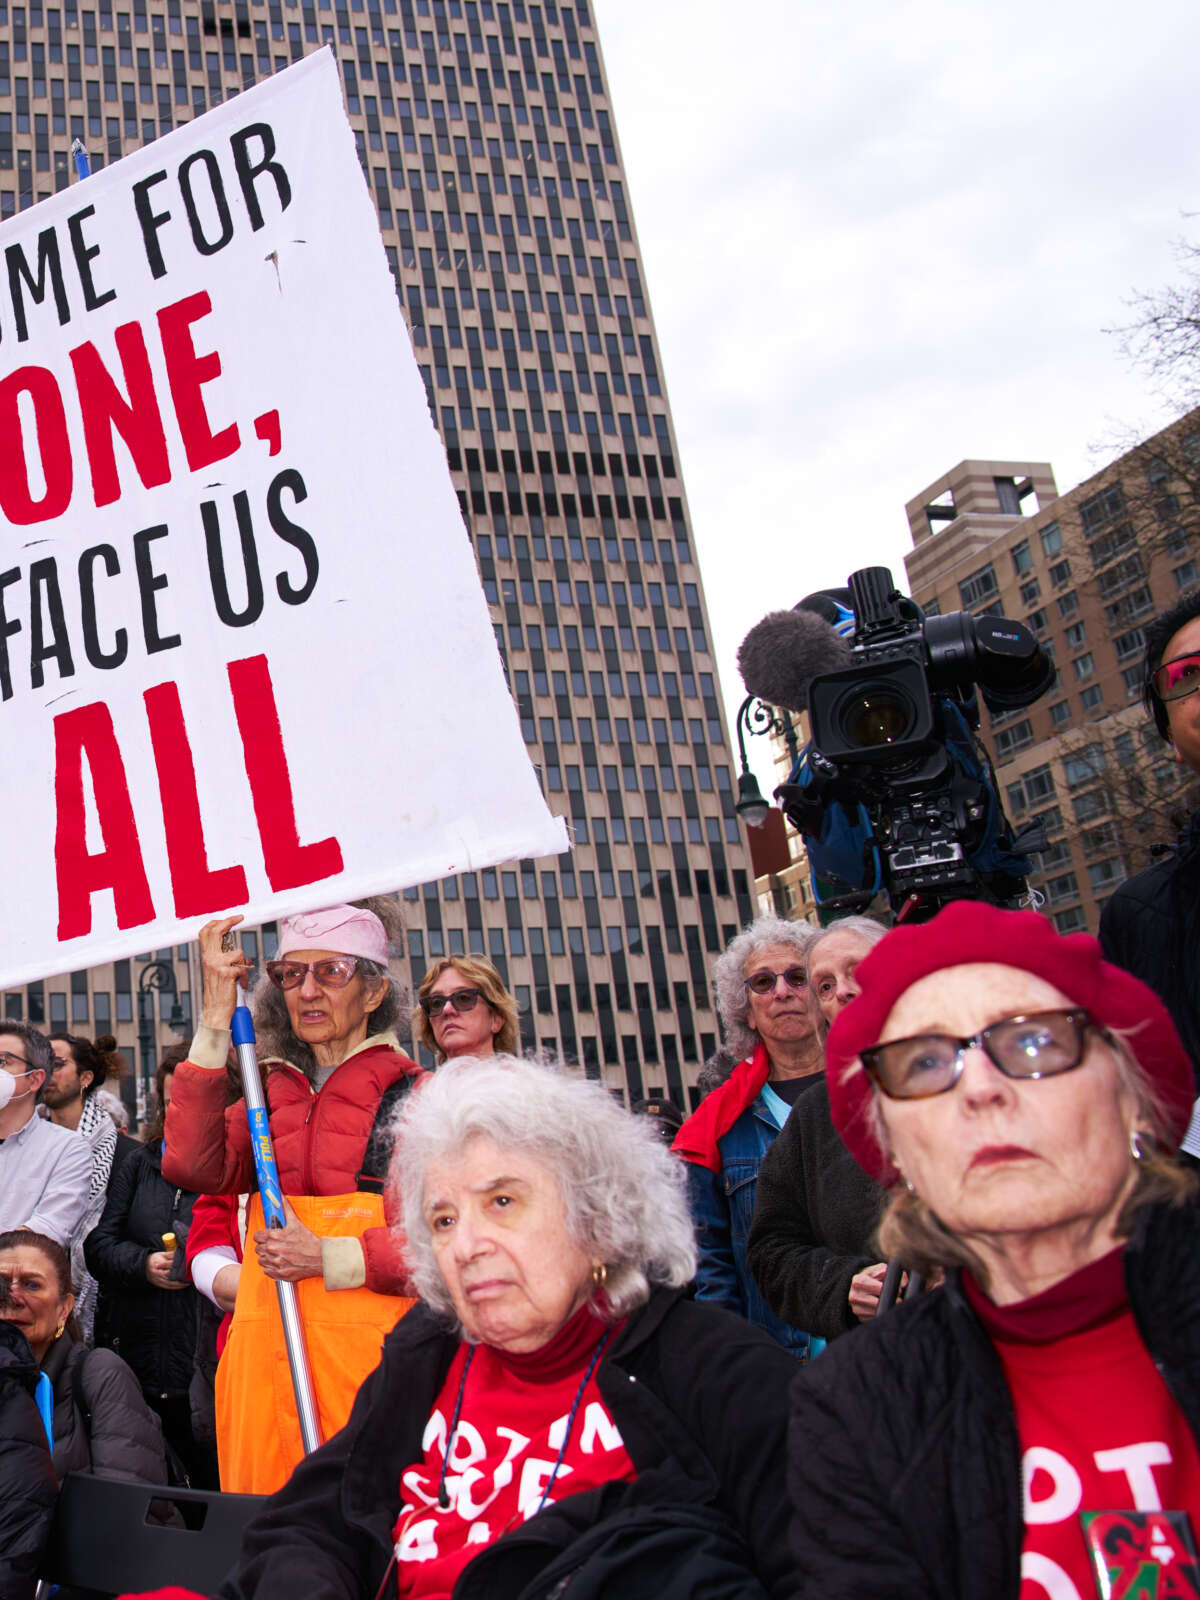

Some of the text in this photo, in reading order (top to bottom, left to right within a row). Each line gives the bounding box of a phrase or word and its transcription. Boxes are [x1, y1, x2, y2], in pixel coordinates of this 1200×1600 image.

[132, 122, 292, 280] FOR
[200, 468, 320, 628] US
[52, 653, 345, 942] ALL
